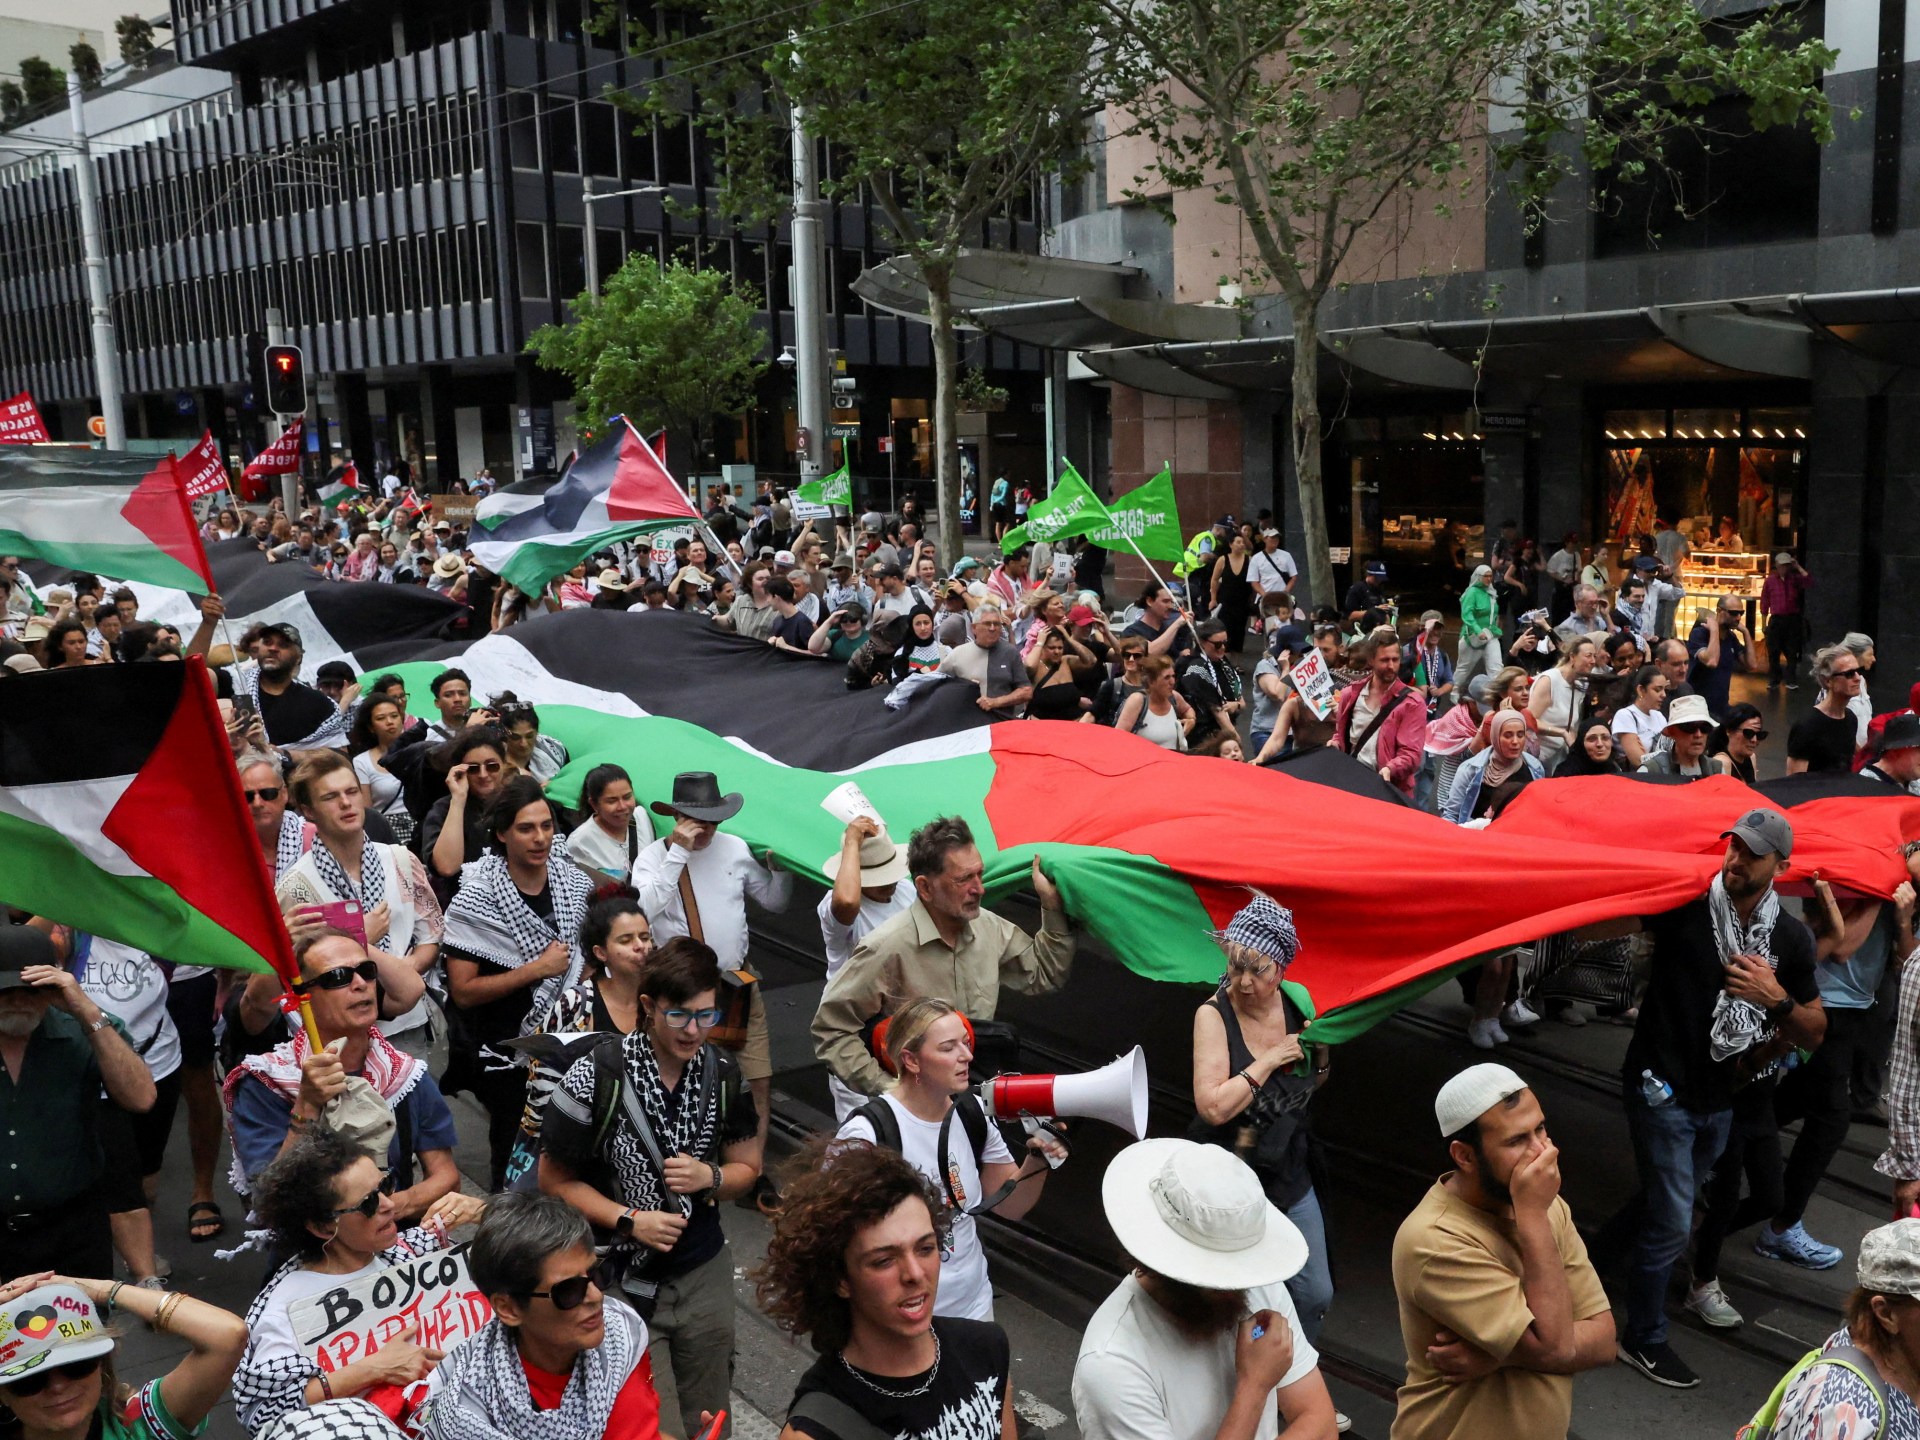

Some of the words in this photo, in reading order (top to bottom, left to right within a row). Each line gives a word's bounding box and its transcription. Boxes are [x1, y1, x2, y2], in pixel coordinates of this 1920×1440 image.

[1485, 416, 1504, 425] HERO
[1505, 416, 1526, 425] SUSHI
[831, 427, 850, 437] George
[851, 427, 857, 436] St
[1295, 654, 1319, 687] STOP
[58, 1320, 93, 1338] BLM
[316, 1290, 492, 1374] APARTHEID
